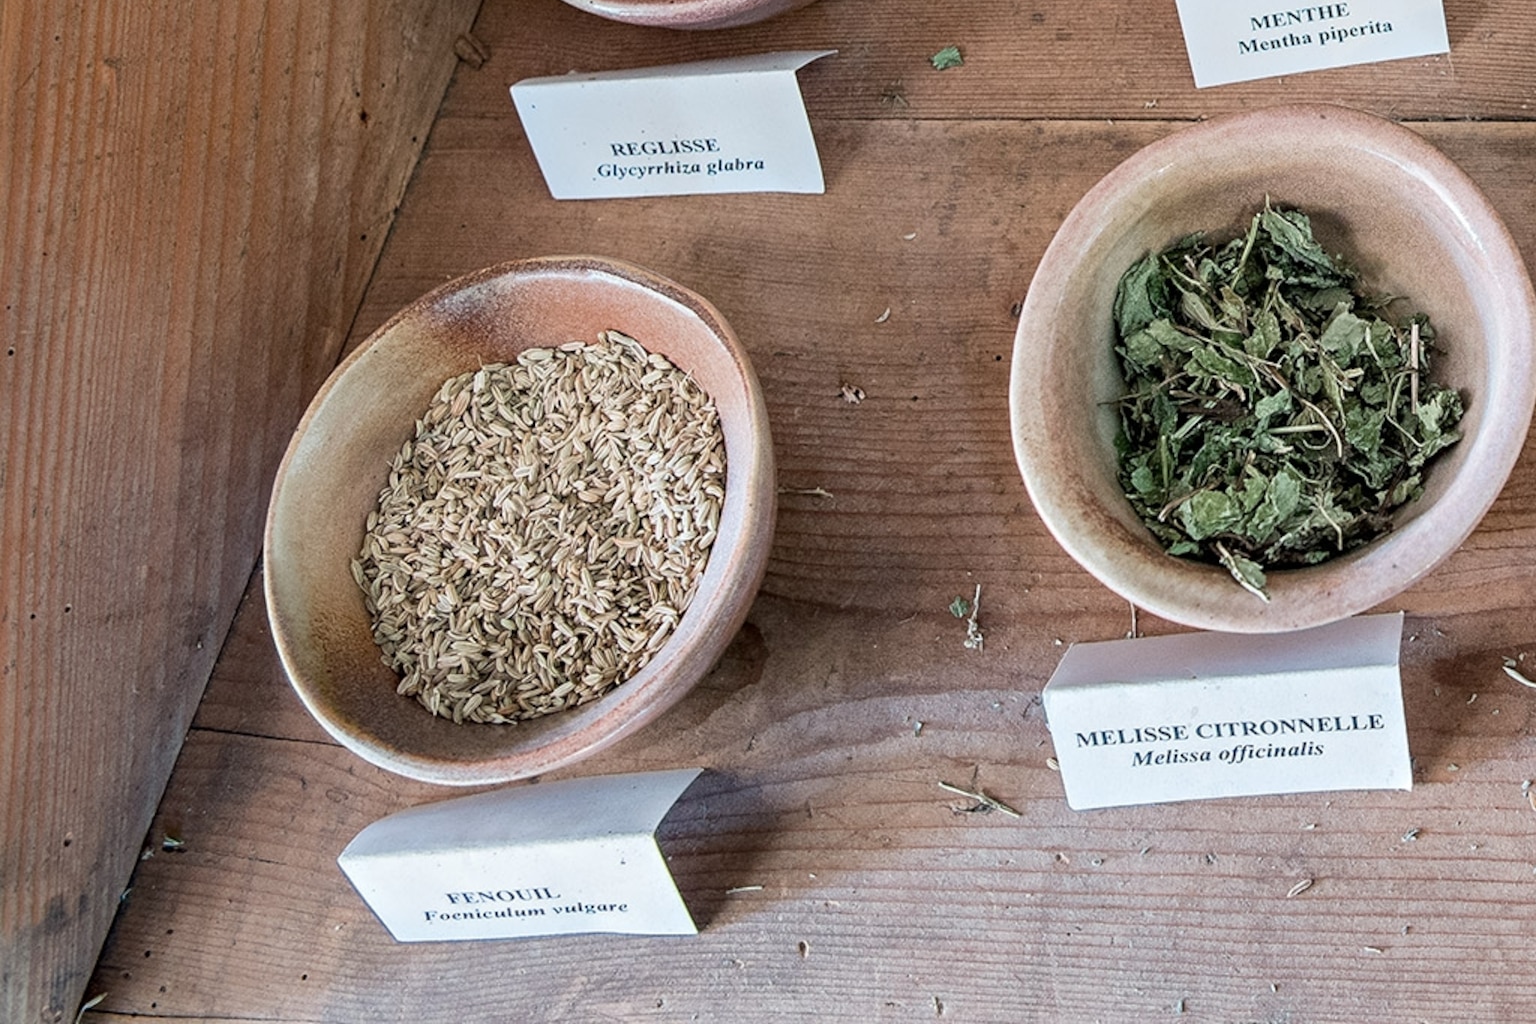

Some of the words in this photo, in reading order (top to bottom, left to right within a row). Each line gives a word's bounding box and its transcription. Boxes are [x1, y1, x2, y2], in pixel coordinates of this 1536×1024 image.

[1250, 2, 1350, 32] MENTHE
[1238, 33, 1312, 55] Mentha
[1318, 21, 1394, 46] piperita
[610, 138, 721, 157] REGLISSE
[596, 161, 701, 180] Glycyrrhiza
[706, 158, 765, 176] glabra
[1076, 724, 1190, 748] MELISSE
[1195, 714, 1386, 741] CITRONNELLE
[1131, 750, 1212, 767] Melissa
[1217, 741, 1325, 764] officinalis
[445, 886, 562, 905] FENOUIL
[424, 907, 546, 921] Foeniculum
[552, 901, 628, 914] vulgare
